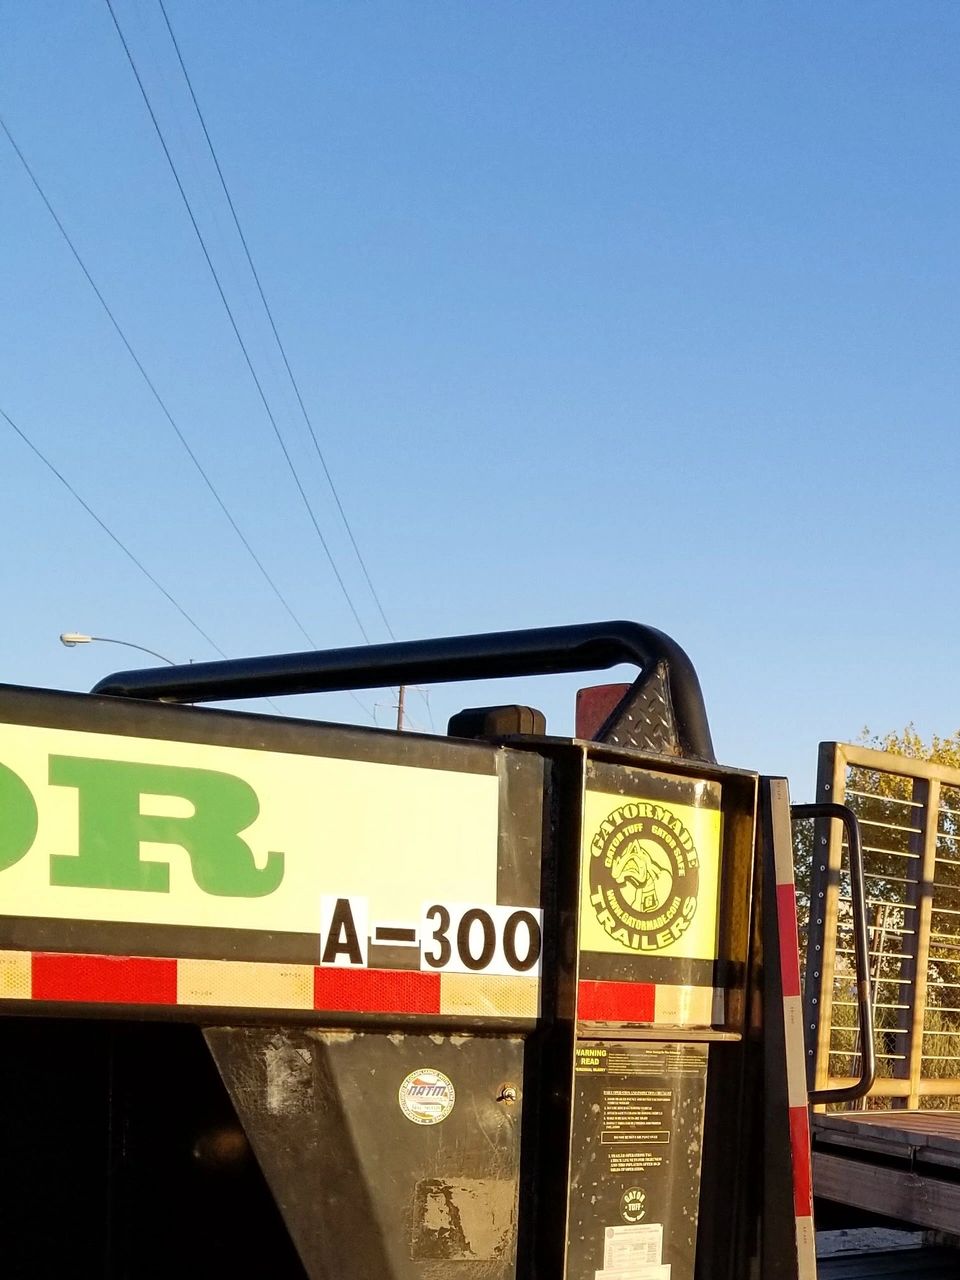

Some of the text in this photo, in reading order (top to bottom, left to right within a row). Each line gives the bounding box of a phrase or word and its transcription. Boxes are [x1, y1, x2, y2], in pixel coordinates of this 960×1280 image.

[0, 753, 285, 899] R
[591, 802, 700, 869] GATORMADE
[604, 822, 644, 869] GATOR TUFF
[651, 825, 687, 877] GATOR SAFE
[321, 897, 542, 972] A-300
[590, 884, 698, 951] TRAILERS
[575, 1049, 607, 1057] WARNING
